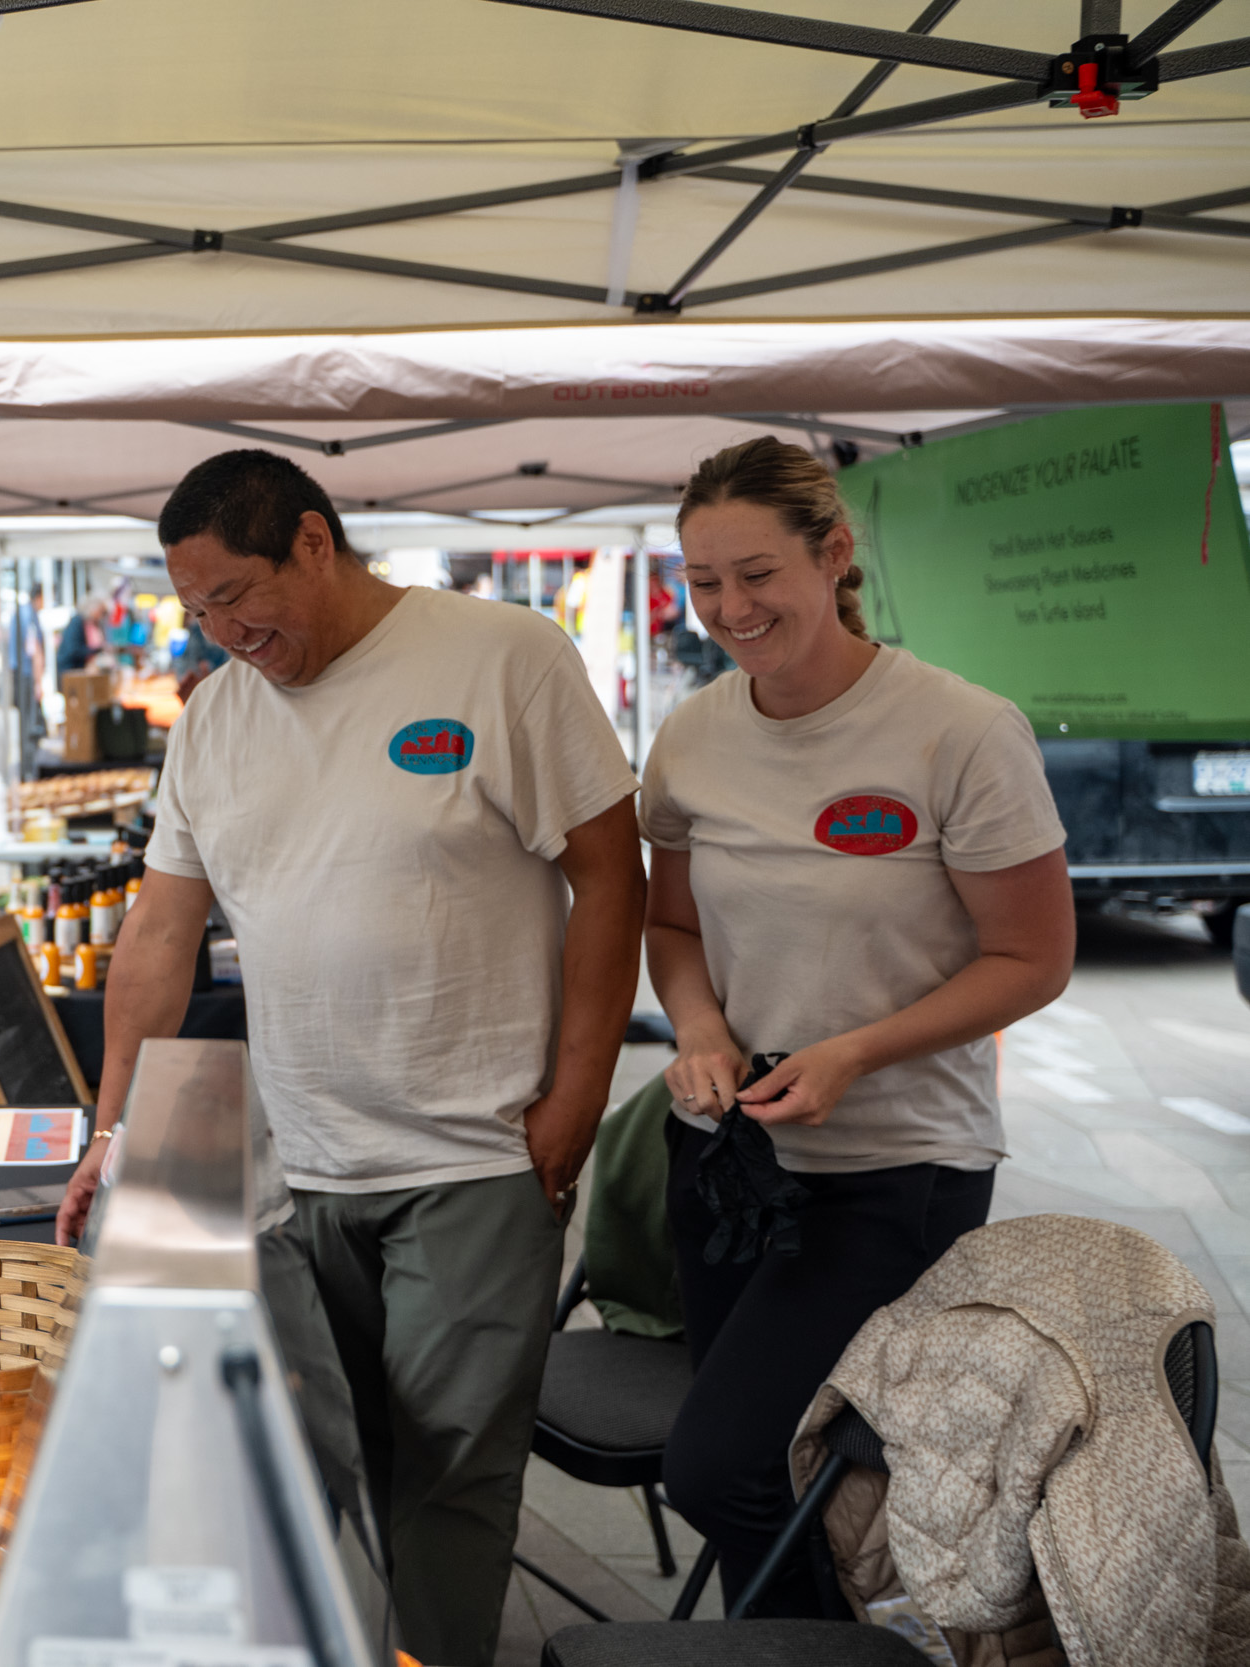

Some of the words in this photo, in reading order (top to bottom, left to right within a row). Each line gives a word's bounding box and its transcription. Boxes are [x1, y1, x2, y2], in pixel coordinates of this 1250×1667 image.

[553, 381, 709, 401] OUTBOUND
[1034, 451, 1077, 488] YOUR
[1079, 435, 1143, 479] PALATE
[1071, 561, 1137, 583] Medicines
